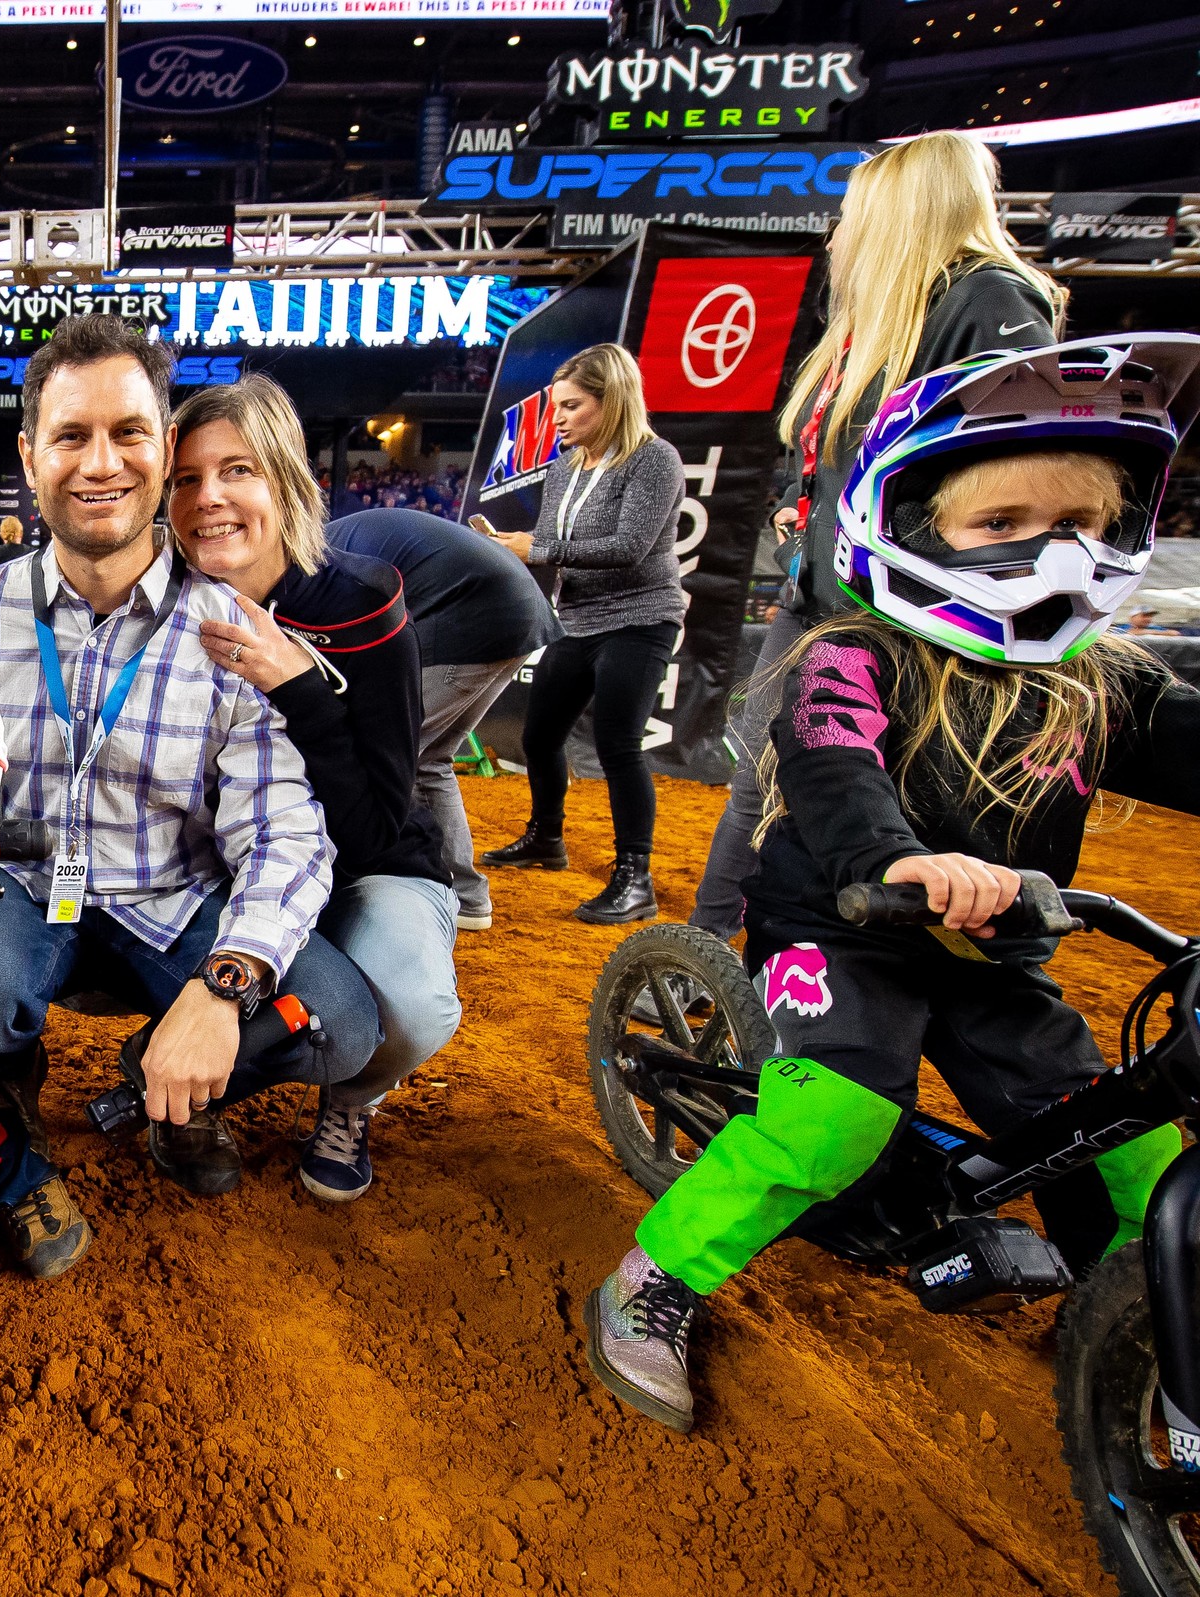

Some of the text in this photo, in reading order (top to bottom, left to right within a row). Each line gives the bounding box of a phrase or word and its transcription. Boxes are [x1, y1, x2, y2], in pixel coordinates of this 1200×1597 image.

[8, 7, 17, 17] A
[22, 6, 56, 17] PEST
[62, 5, 94, 16] FREE
[256, 2, 339, 13] INTRUDERS
[345, 1, 411, 12] BEWARE!
[418, 1, 450, 12] THIS
[456, 1, 470, 11] IS
[476, 1, 486, 11] A
[491, 1, 527, 11] PEST
[533, 0, 567, 11] FREE
[136, 45, 252, 99] Ford
[566, 47, 860, 102] MONSTER
[609, 107, 817, 131] ENERGY
[456, 129, 514, 153] AMA
[437, 151, 869, 200] SUPERCRO
[138, 225, 226, 236] ROCKY MOUNTAIN
[562, 214, 604, 236] FIM
[611, 213, 663, 237] World
[1060, 403, 1097, 417] FOX
[57, 865, 86, 877] 2020
[767, 1057, 818, 1088] FOX
[921, 1253, 973, 1287] STACYC
